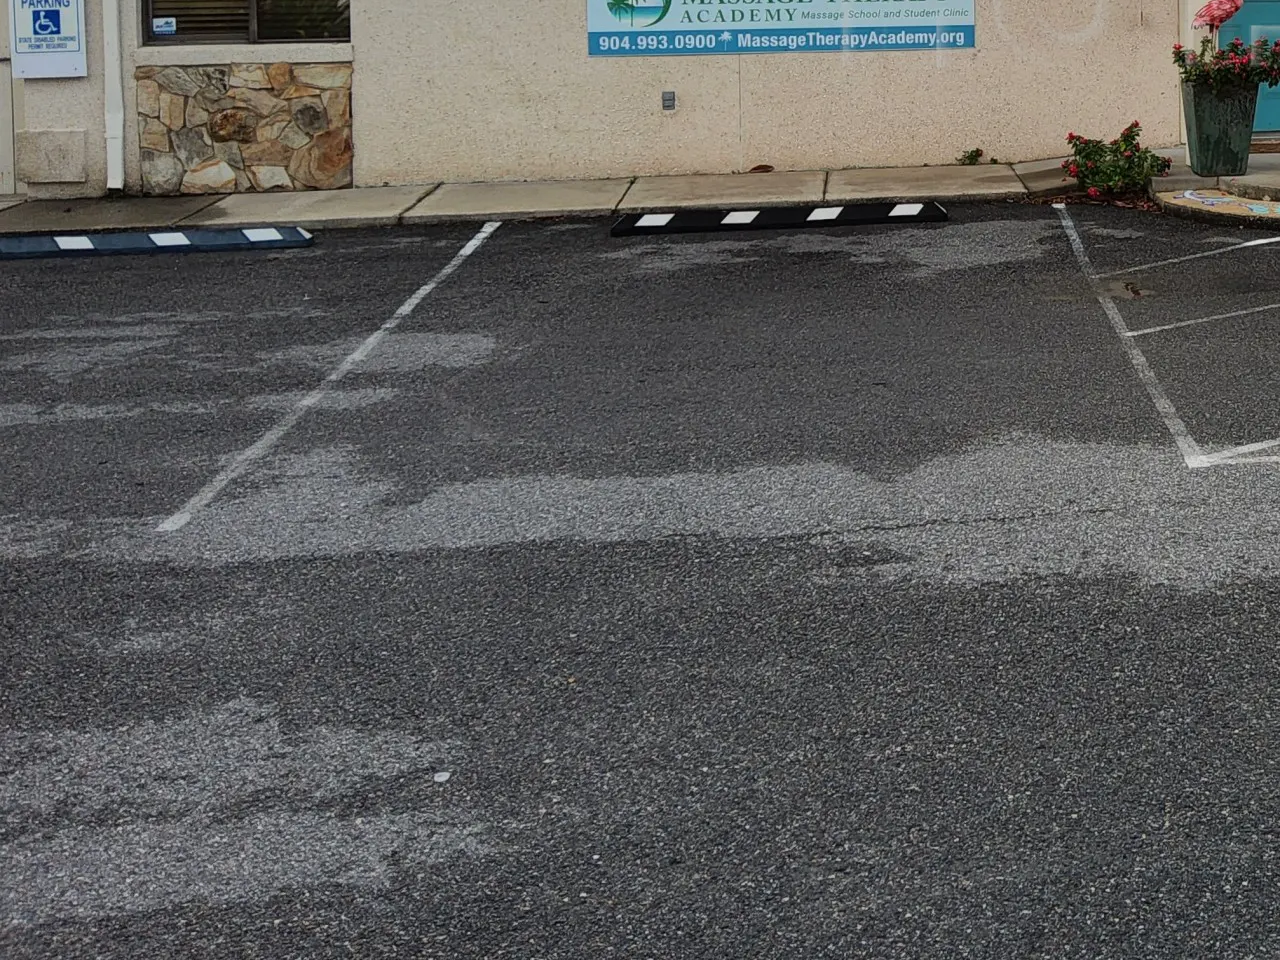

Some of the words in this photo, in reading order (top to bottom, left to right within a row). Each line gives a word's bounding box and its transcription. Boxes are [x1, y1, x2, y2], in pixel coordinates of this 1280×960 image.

[681, 9, 797, 23] ACADEMY
[802, 10, 844, 21] Massage
[848, 9, 880, 19] School
[884, 9, 901, 18] and
[904, 8, 940, 18] Student
[943, 8, 969, 17] Clinic
[600, 34, 715, 50] 904.993.0900
[738, 31, 964, 50] MassageTherapyAcademy.org
